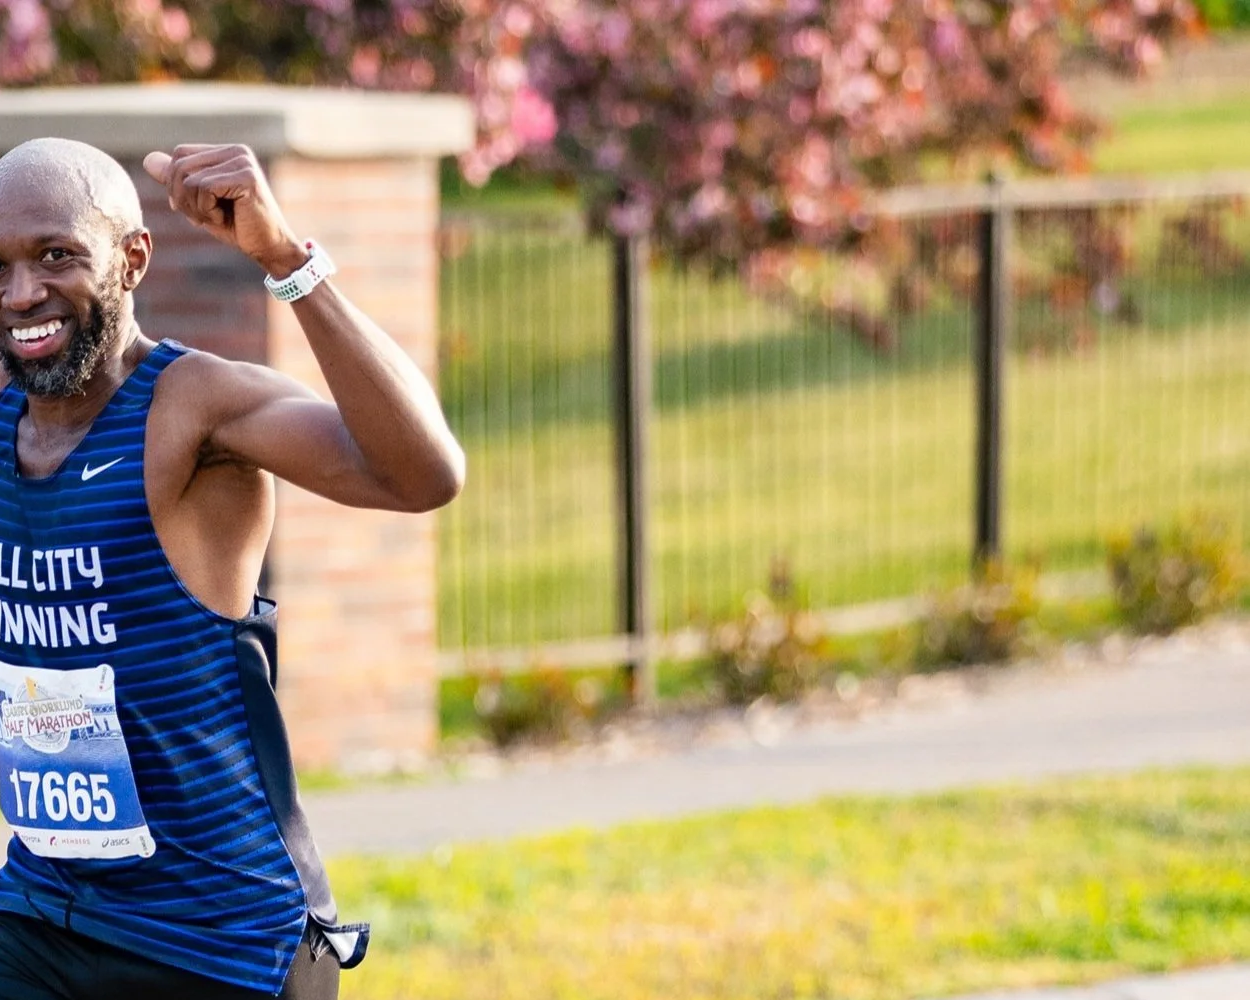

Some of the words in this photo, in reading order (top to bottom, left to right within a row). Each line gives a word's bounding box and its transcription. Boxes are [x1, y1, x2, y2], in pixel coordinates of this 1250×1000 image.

[31, 546, 104, 593] CITY
[4, 719, 24, 736] HALF
[27, 711, 92, 736] MARATHON
[9, 767, 117, 822] 17665
[110, 837, 131, 847] asics
